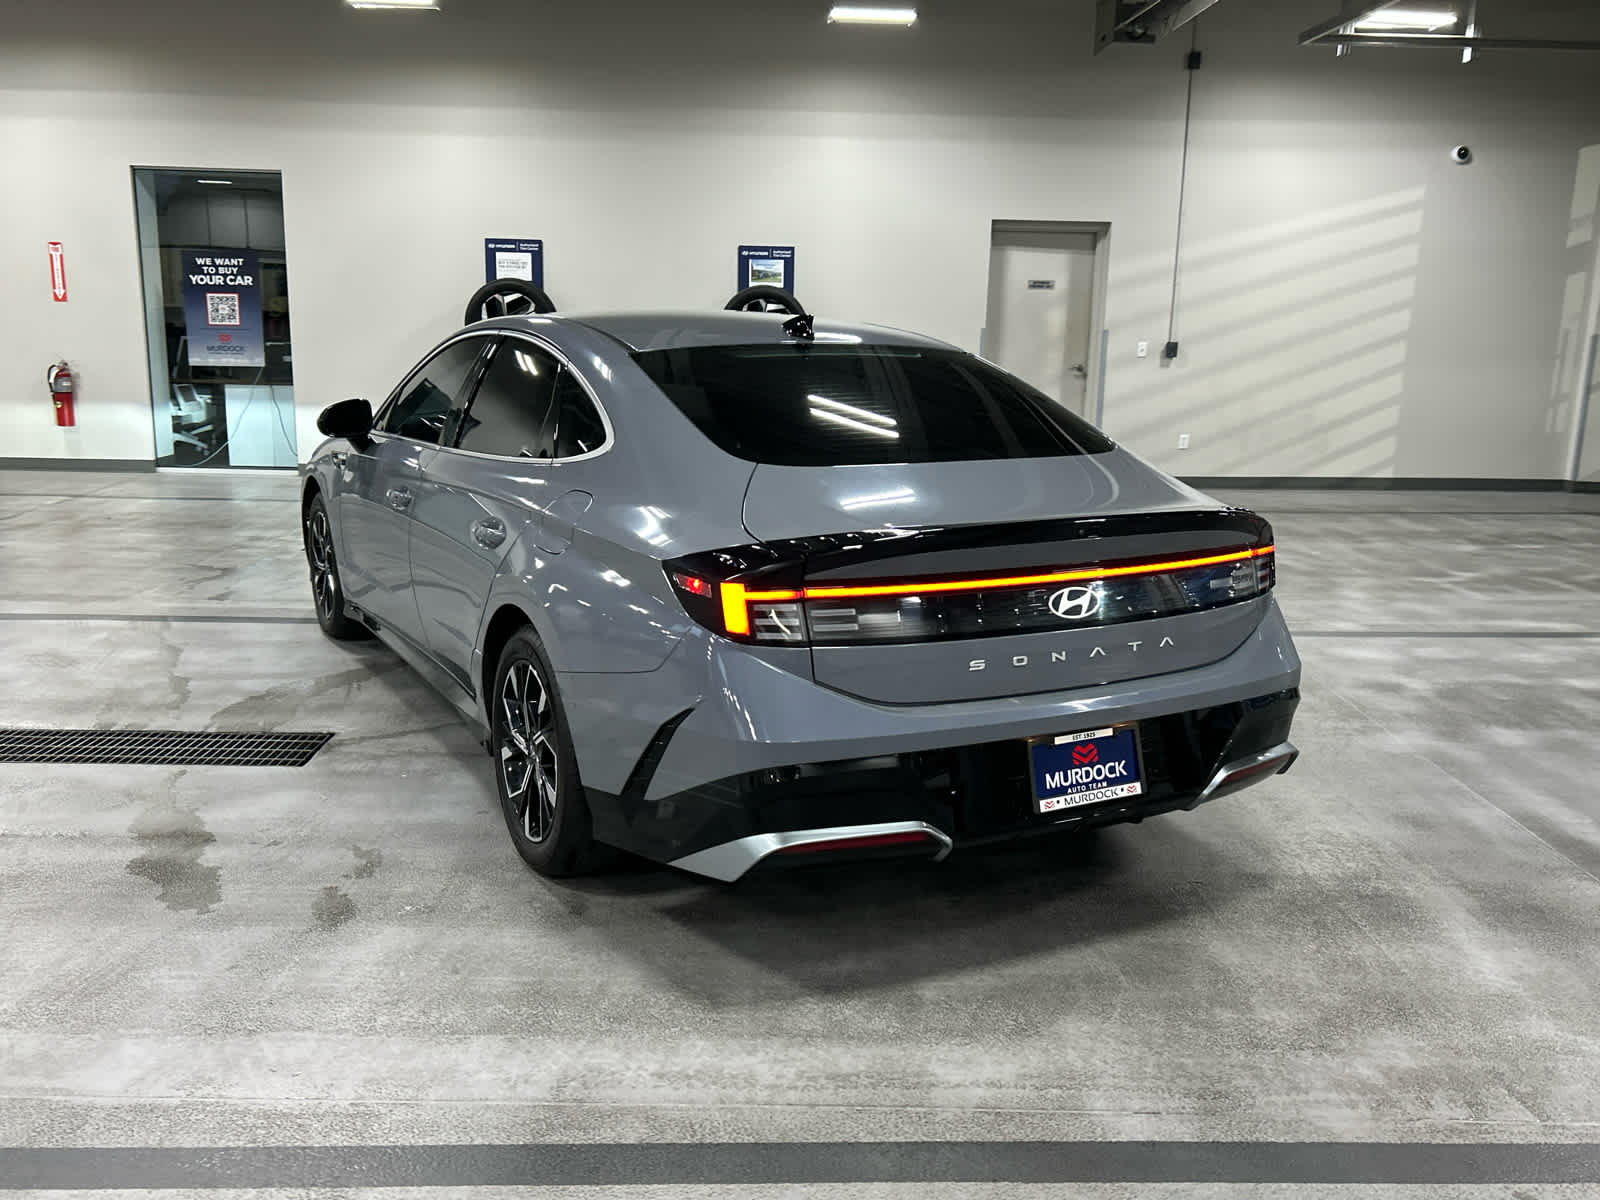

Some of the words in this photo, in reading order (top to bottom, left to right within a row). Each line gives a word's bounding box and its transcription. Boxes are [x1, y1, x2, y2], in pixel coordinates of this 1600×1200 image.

[195, 257, 212, 265] WE
[215, 258, 244, 266] WANT
[202, 266, 216, 274] TO
[189, 274, 224, 285] YOUR
[226, 275, 253, 286] CAR
[968, 636, 1174, 671] SONATA
[1045, 760, 1128, 789] MURDOCK
[1067, 785, 1087, 794] AUTO
[1089, 781, 1108, 791] TEAM
[1064, 788, 1119, 806] MURDOCK
